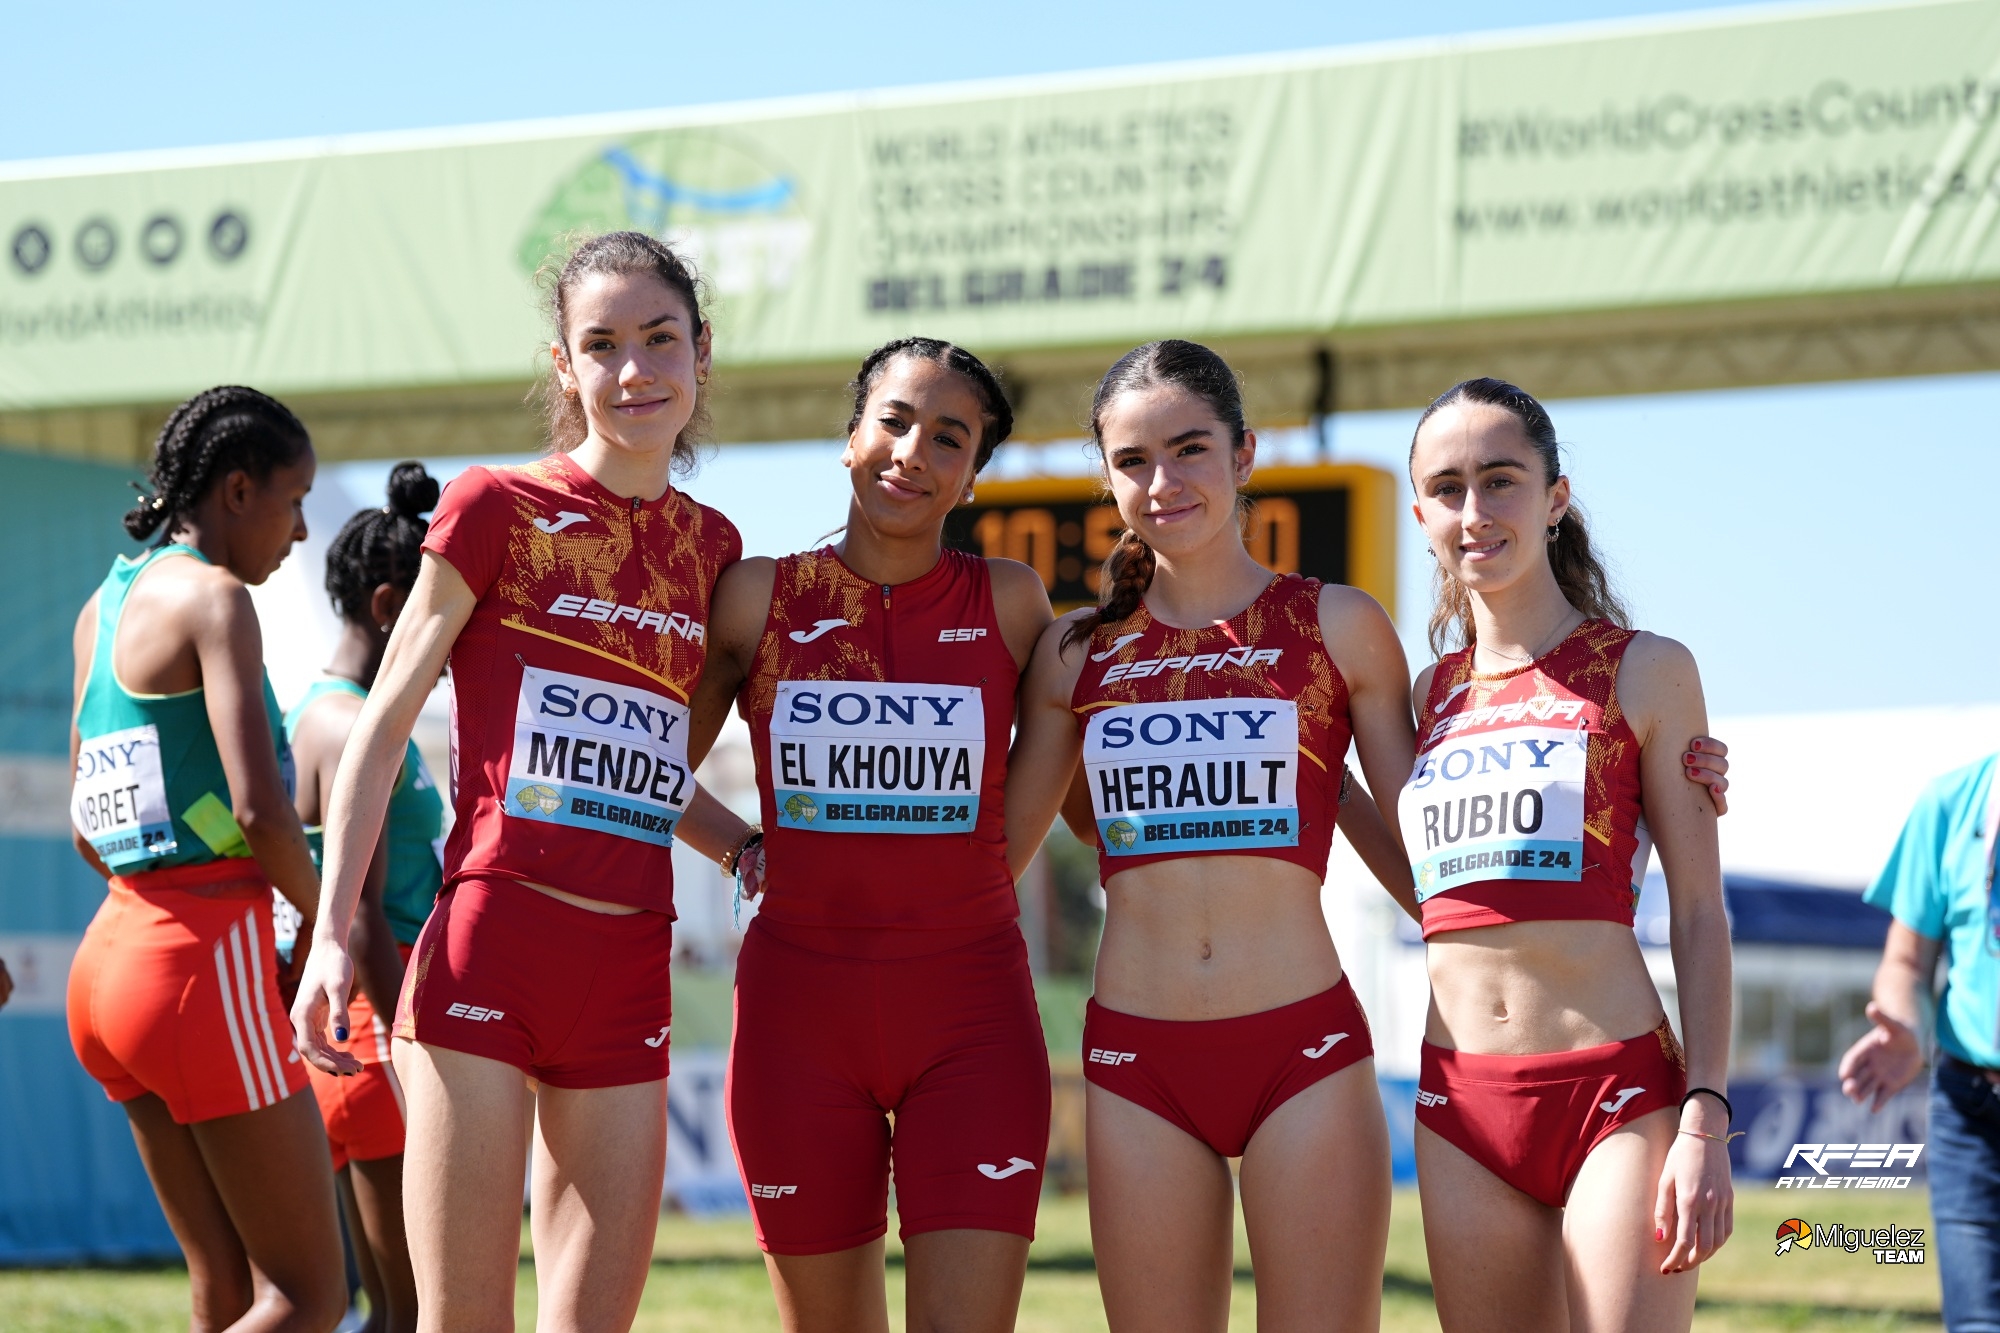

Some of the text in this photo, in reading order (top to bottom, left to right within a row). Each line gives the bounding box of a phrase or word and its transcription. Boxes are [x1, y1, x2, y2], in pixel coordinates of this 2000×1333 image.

[870, 127, 1004, 167] WORLD
[868, 173, 1005, 211] CROSS
[868, 257, 1227, 311] BELGRADE 24
[547, 594, 705, 645] ESPAÑA
[938, 628, 987, 642] ESP
[1099, 646, 1283, 687] ESPAÑA
[540, 684, 679, 744] SONY
[789, 691, 964, 726] SONY
[1101, 710, 1276, 750] SONY
[526, 731, 686, 807] MENDEZ
[780, 742, 972, 791] EL KHOUYA
[1412, 739, 1565, 791] SONY
[1098, 760, 1286, 814] HERAULT
[570, 797, 674, 835] BELGRADE 24
[826, 803, 970, 822] BELGRADE 24
[1143, 818, 1290, 842] BELGRADE 24
[1422, 788, 1544, 851] RUBIO
[1439, 849, 1572, 879] BELGRADE 24
[446, 1002, 505, 1023] ESP
[1088, 1048, 1137, 1066] ESP
[751, 1183, 797, 1199] ESP
